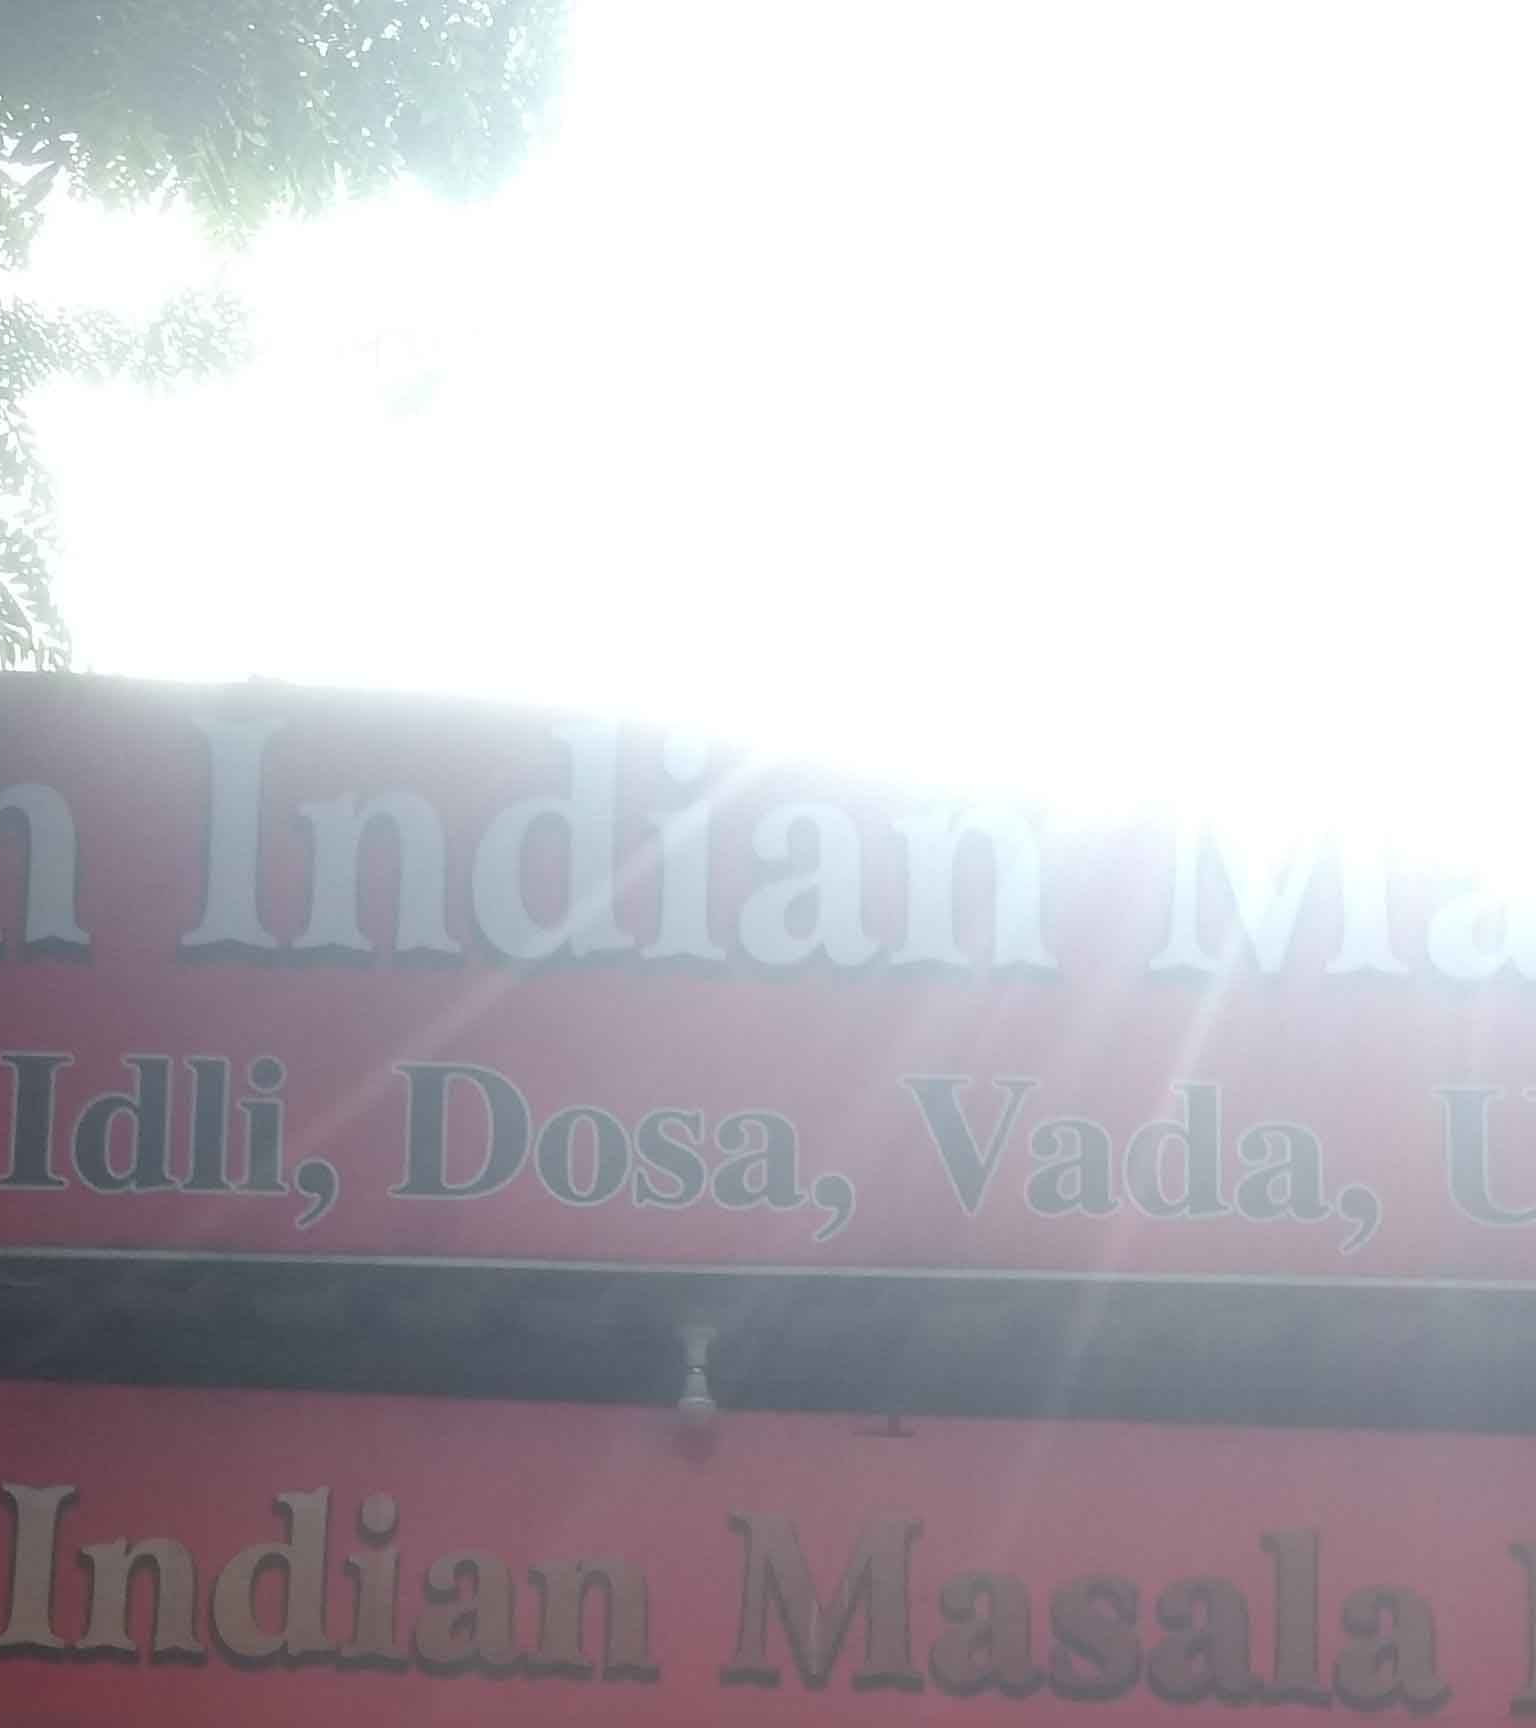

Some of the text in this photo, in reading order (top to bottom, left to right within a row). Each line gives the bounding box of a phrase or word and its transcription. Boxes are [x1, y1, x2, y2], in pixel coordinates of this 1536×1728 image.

[178, 710, 1061, 968] Indian
[389, 1060, 856, 1241] Dosa,
[900, 1074, 1384, 1254] Vada,
[717, 1511, 1452, 1714] Masala
